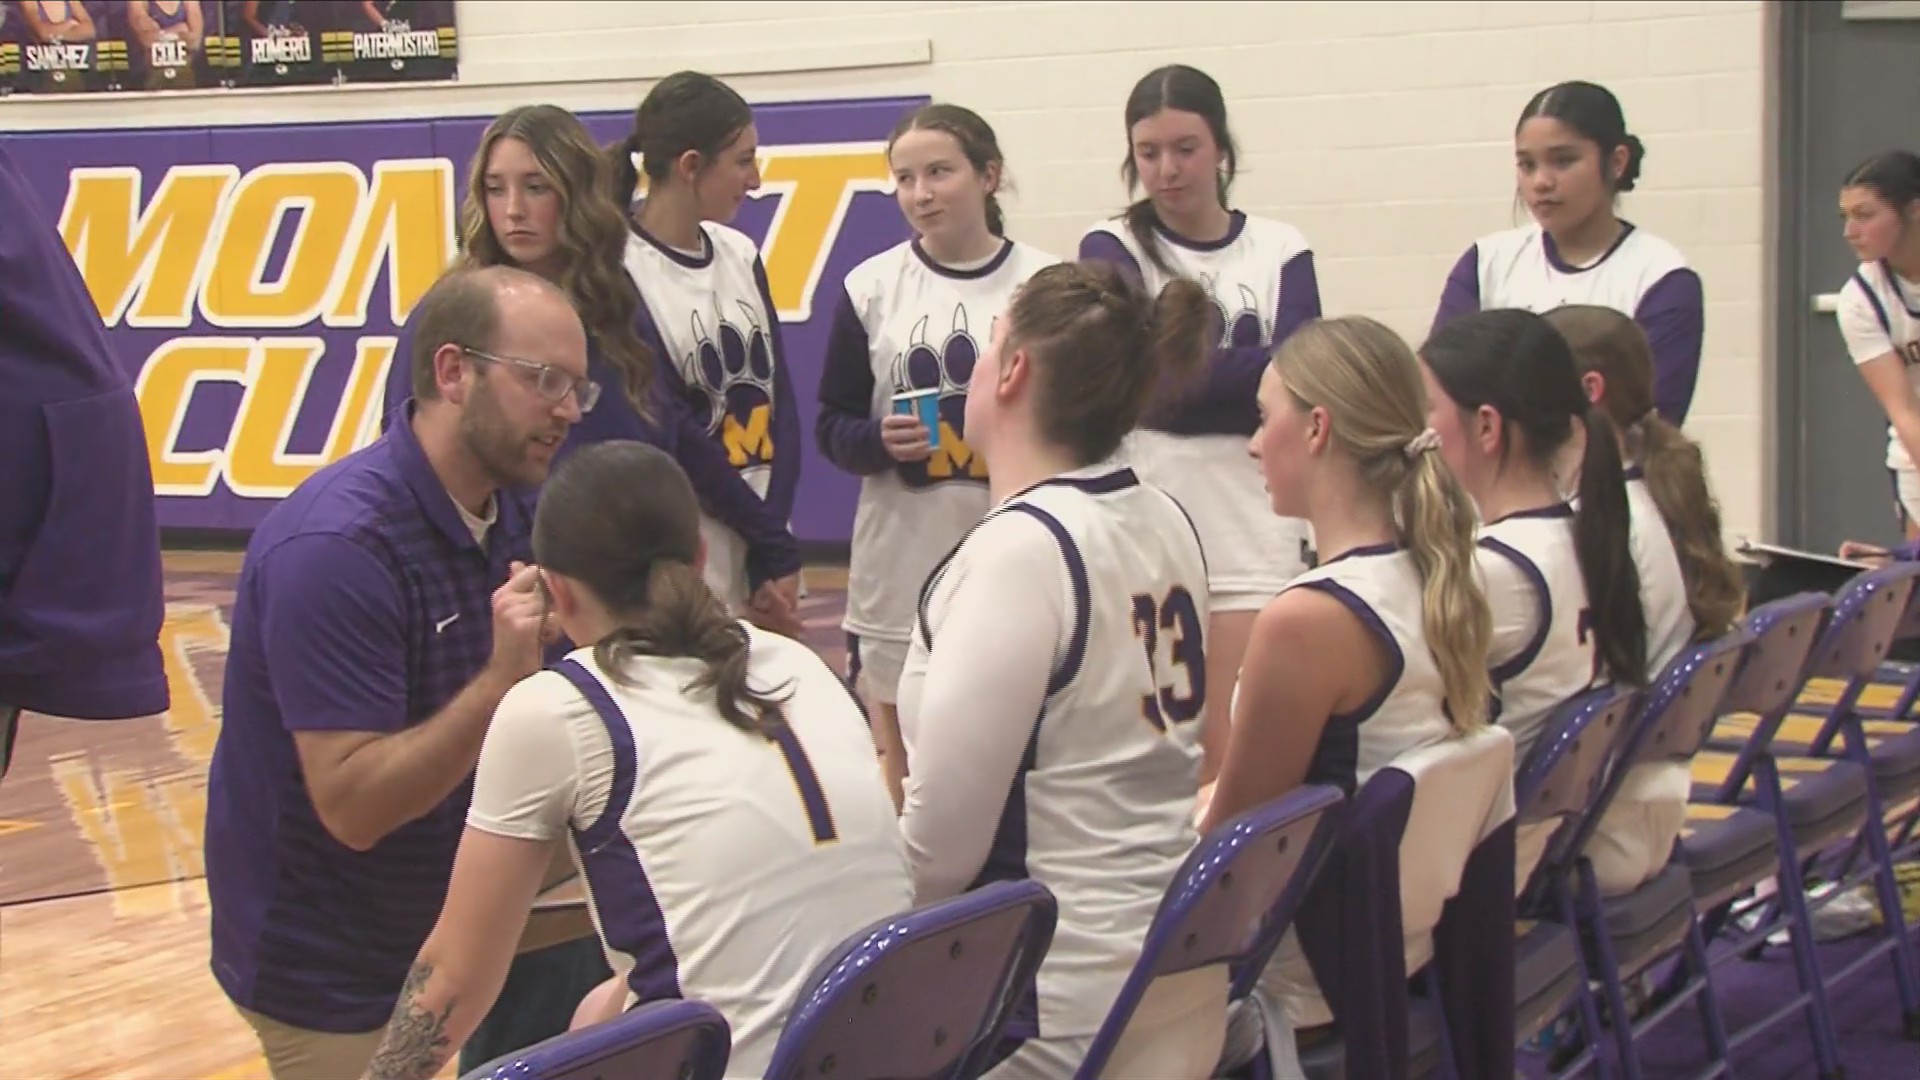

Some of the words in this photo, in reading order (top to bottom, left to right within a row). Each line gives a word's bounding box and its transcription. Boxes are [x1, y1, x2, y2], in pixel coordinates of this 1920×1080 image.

[26, 44, 89, 71] SANCHEZ
[152, 41, 187, 67] COLE
[251, 36, 311, 64] ROMERO
[722, 404, 774, 466] M
[927, 420, 989, 479] M
